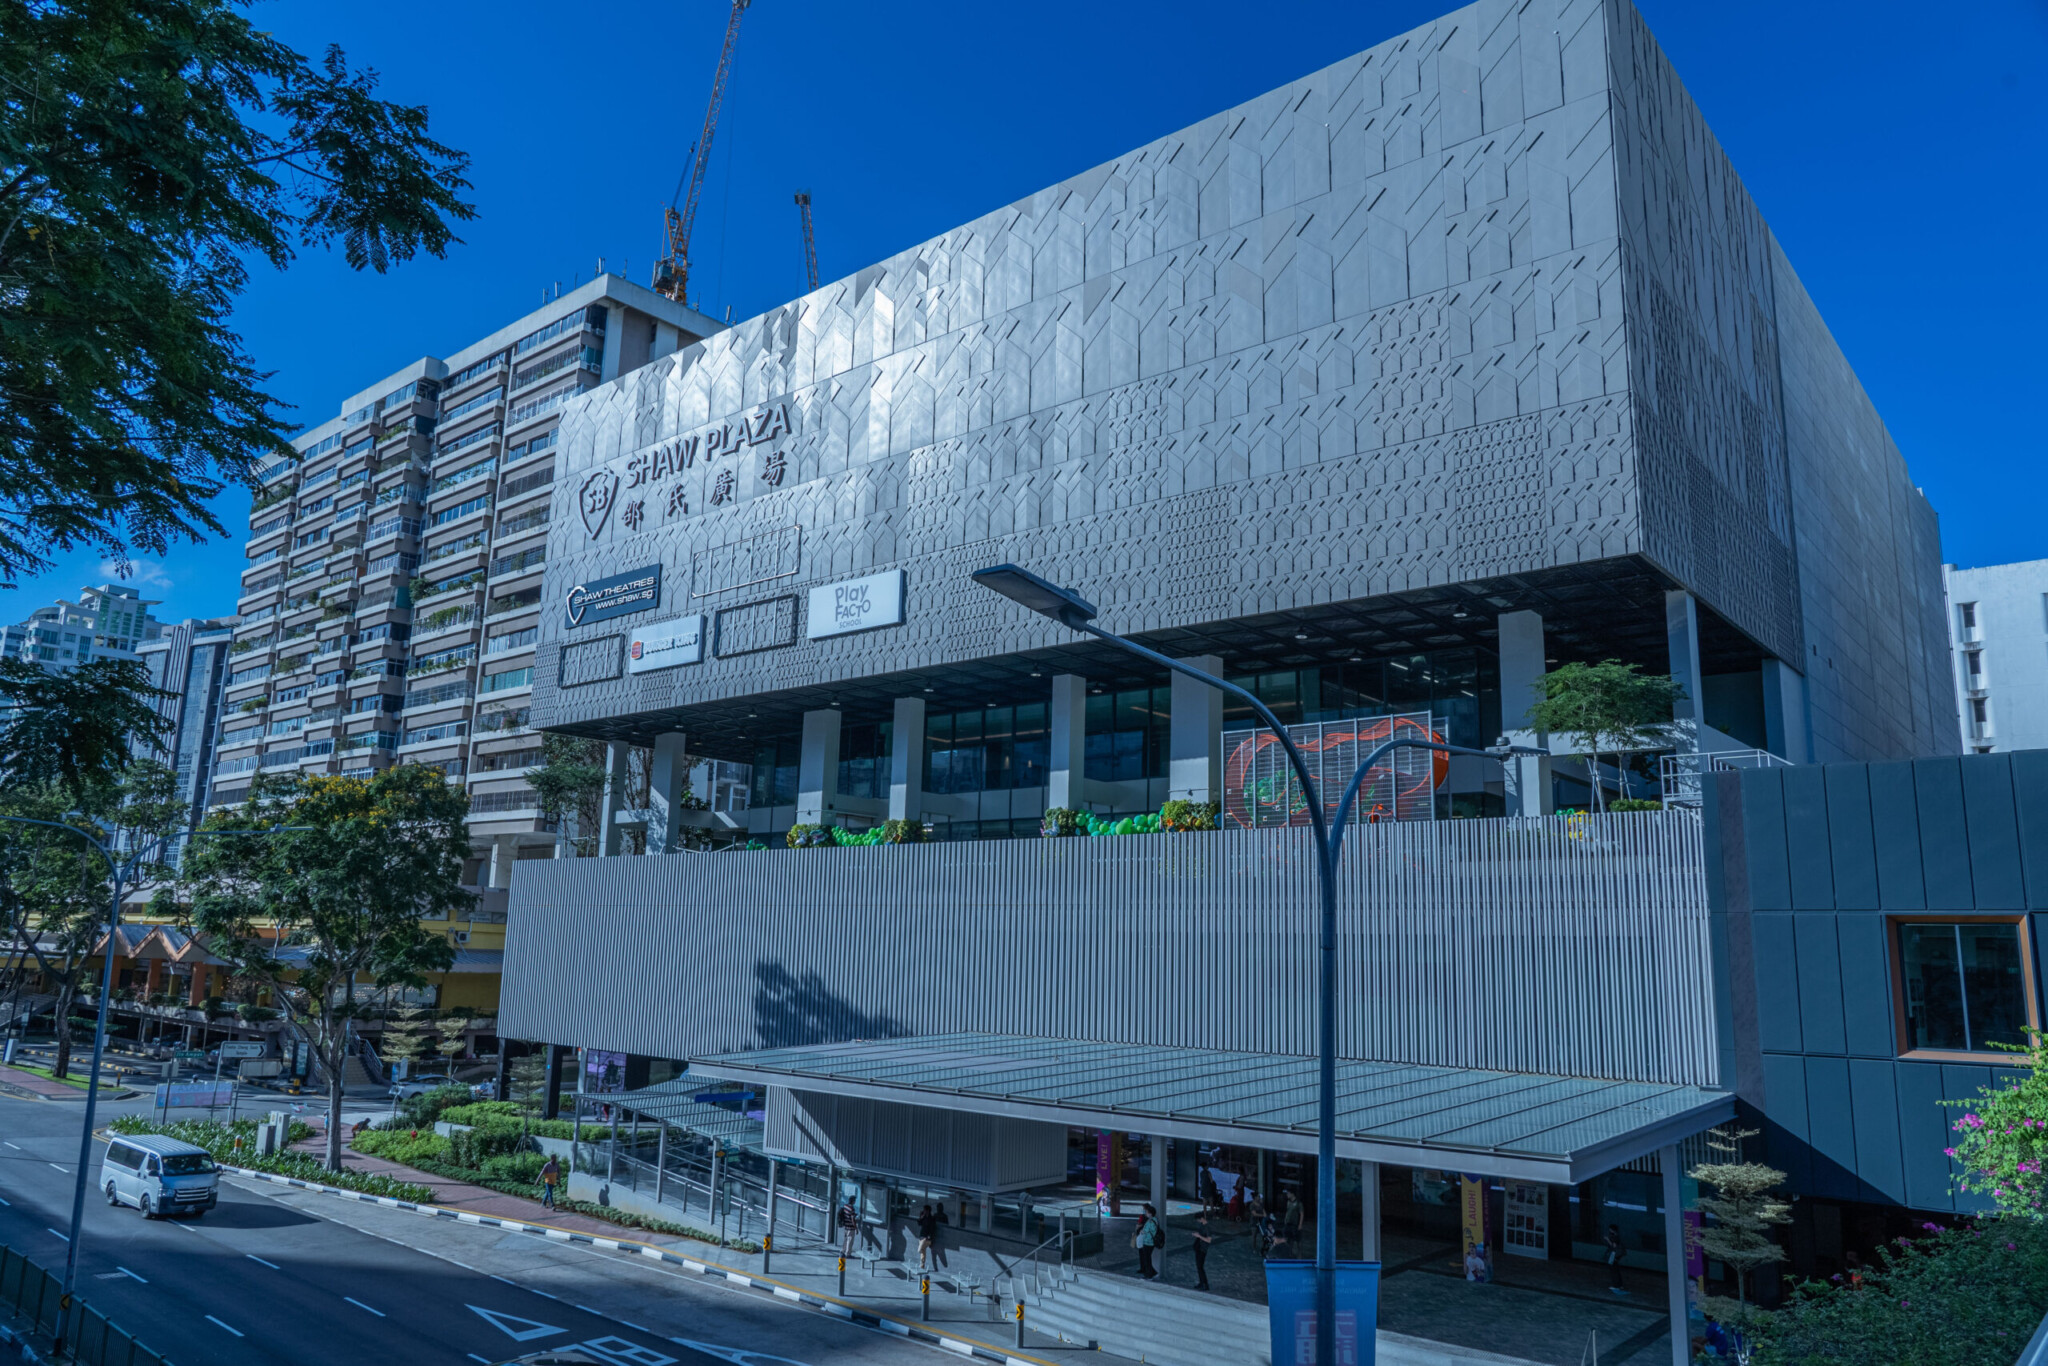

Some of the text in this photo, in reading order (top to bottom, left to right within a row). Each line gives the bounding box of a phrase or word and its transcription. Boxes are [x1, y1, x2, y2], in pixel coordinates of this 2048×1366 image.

[625, 404, 792, 489] SHAW PLAZA
[621, 450, 788, 531] 邵氏廣場
[574, 576, 655, 604] SHAW THEATRES
[595, 589, 654, 610] www.shaw.sg
[835, 585, 869, 604] Play
[835, 599, 871, 622] FACTO
[839, 618, 862, 629] SCHOOL
[1101, 1144, 1109, 1170] LIVE!
[1468, 1189, 1477, 1227] LAUGH!
[1684, 1218, 1696, 1260] LEARN!
